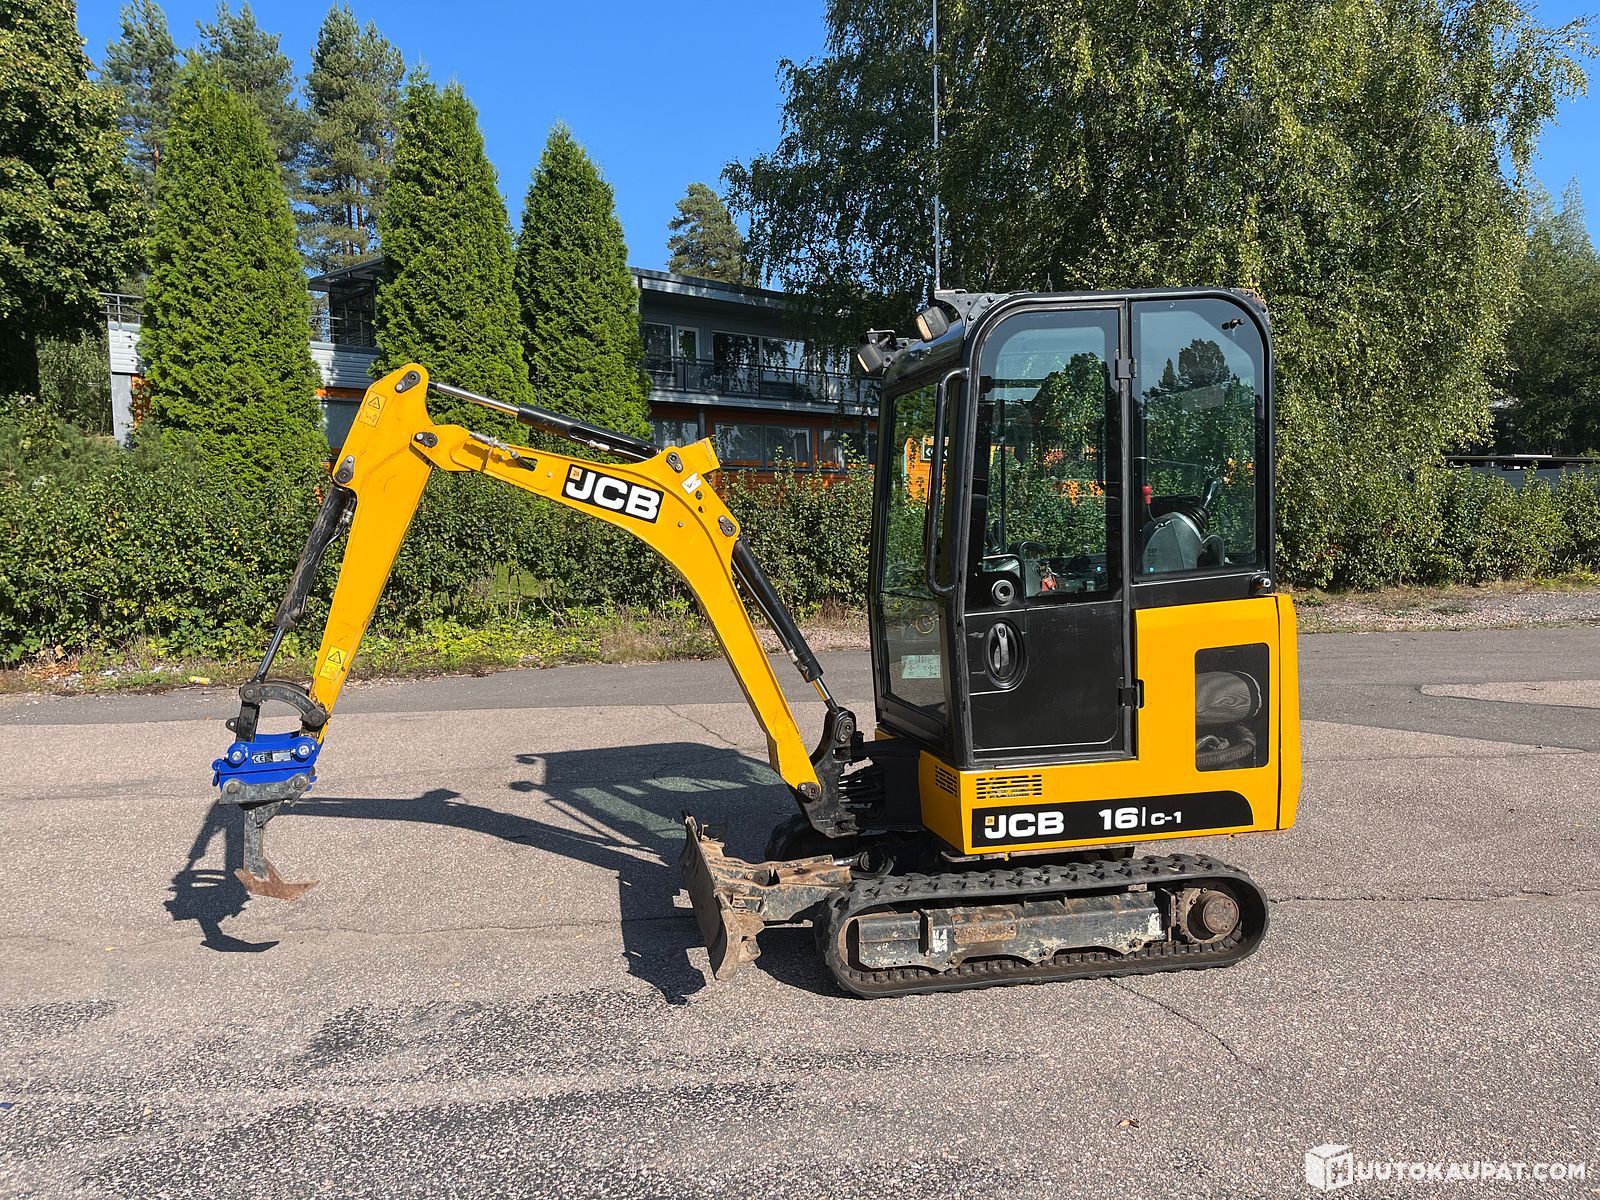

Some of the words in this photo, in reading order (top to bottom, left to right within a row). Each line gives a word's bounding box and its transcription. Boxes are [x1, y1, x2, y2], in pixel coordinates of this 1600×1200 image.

[565, 470, 660, 520] JCB
[254, 755, 264, 763] CE
[984, 811, 1065, 839] JCB
